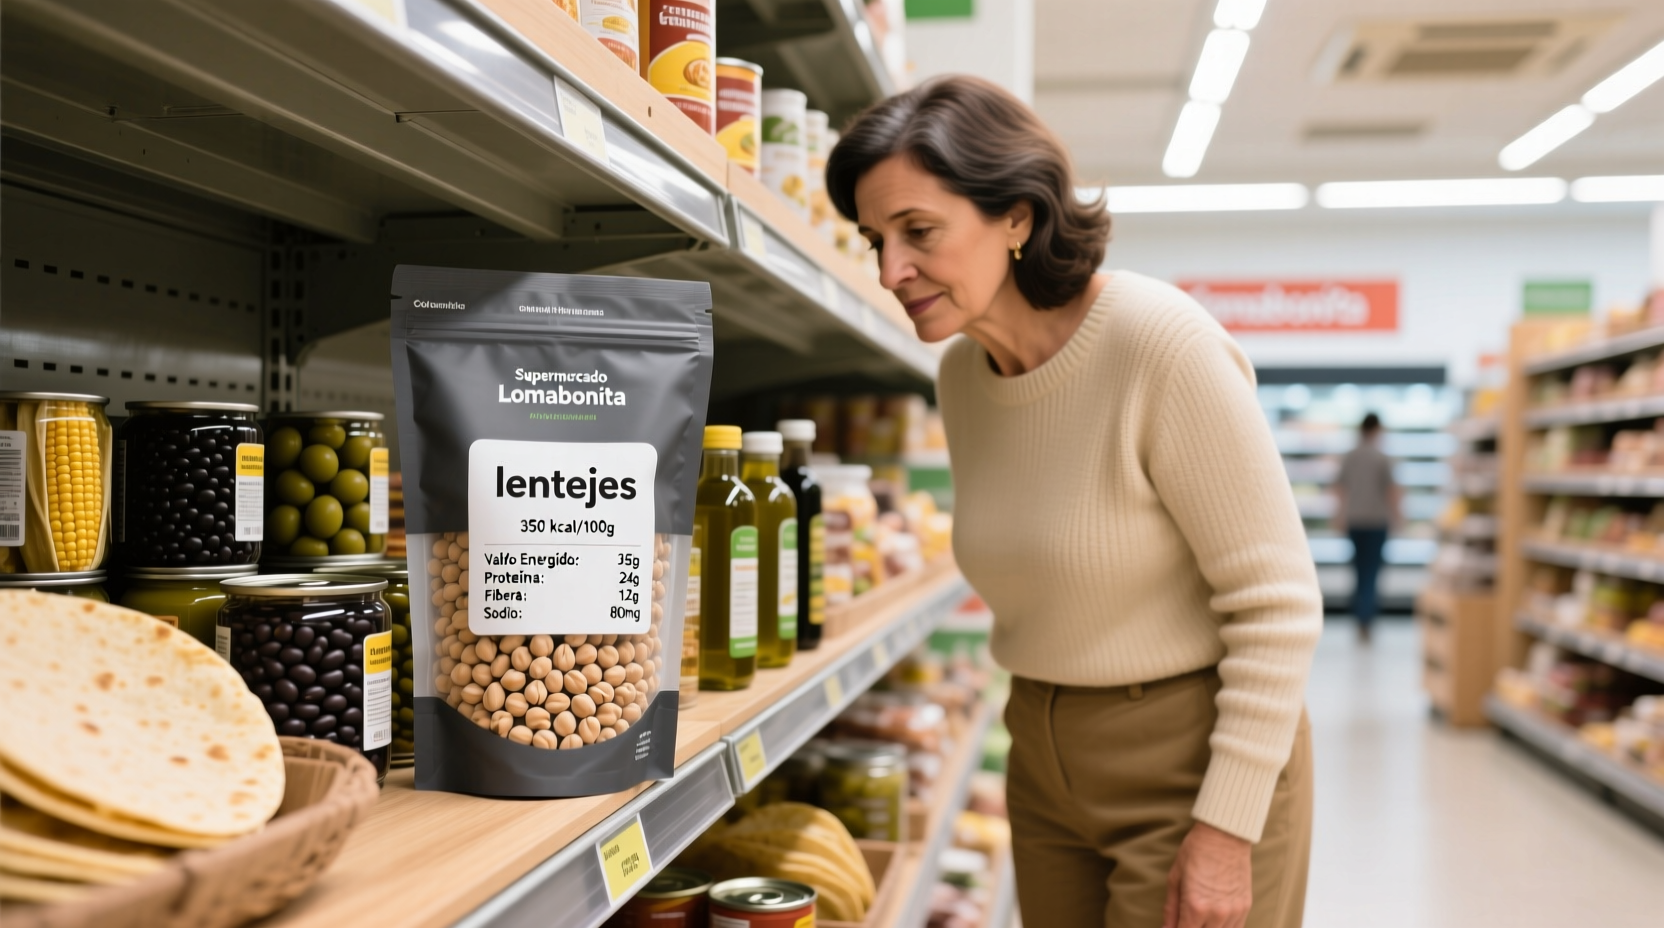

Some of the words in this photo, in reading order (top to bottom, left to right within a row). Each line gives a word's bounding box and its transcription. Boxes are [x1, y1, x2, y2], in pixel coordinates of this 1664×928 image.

[498, 383, 626, 406] Lomabonita
[496, 465, 637, 509] lentejes
[520, 518, 546, 533] 350
[549, 518, 615, 538] kcal/100g
[617, 553, 640, 570] 35g
[618, 571, 640, 588] 24g
[618, 588, 639, 605] 12g
[609, 605, 641, 623] 80mg
